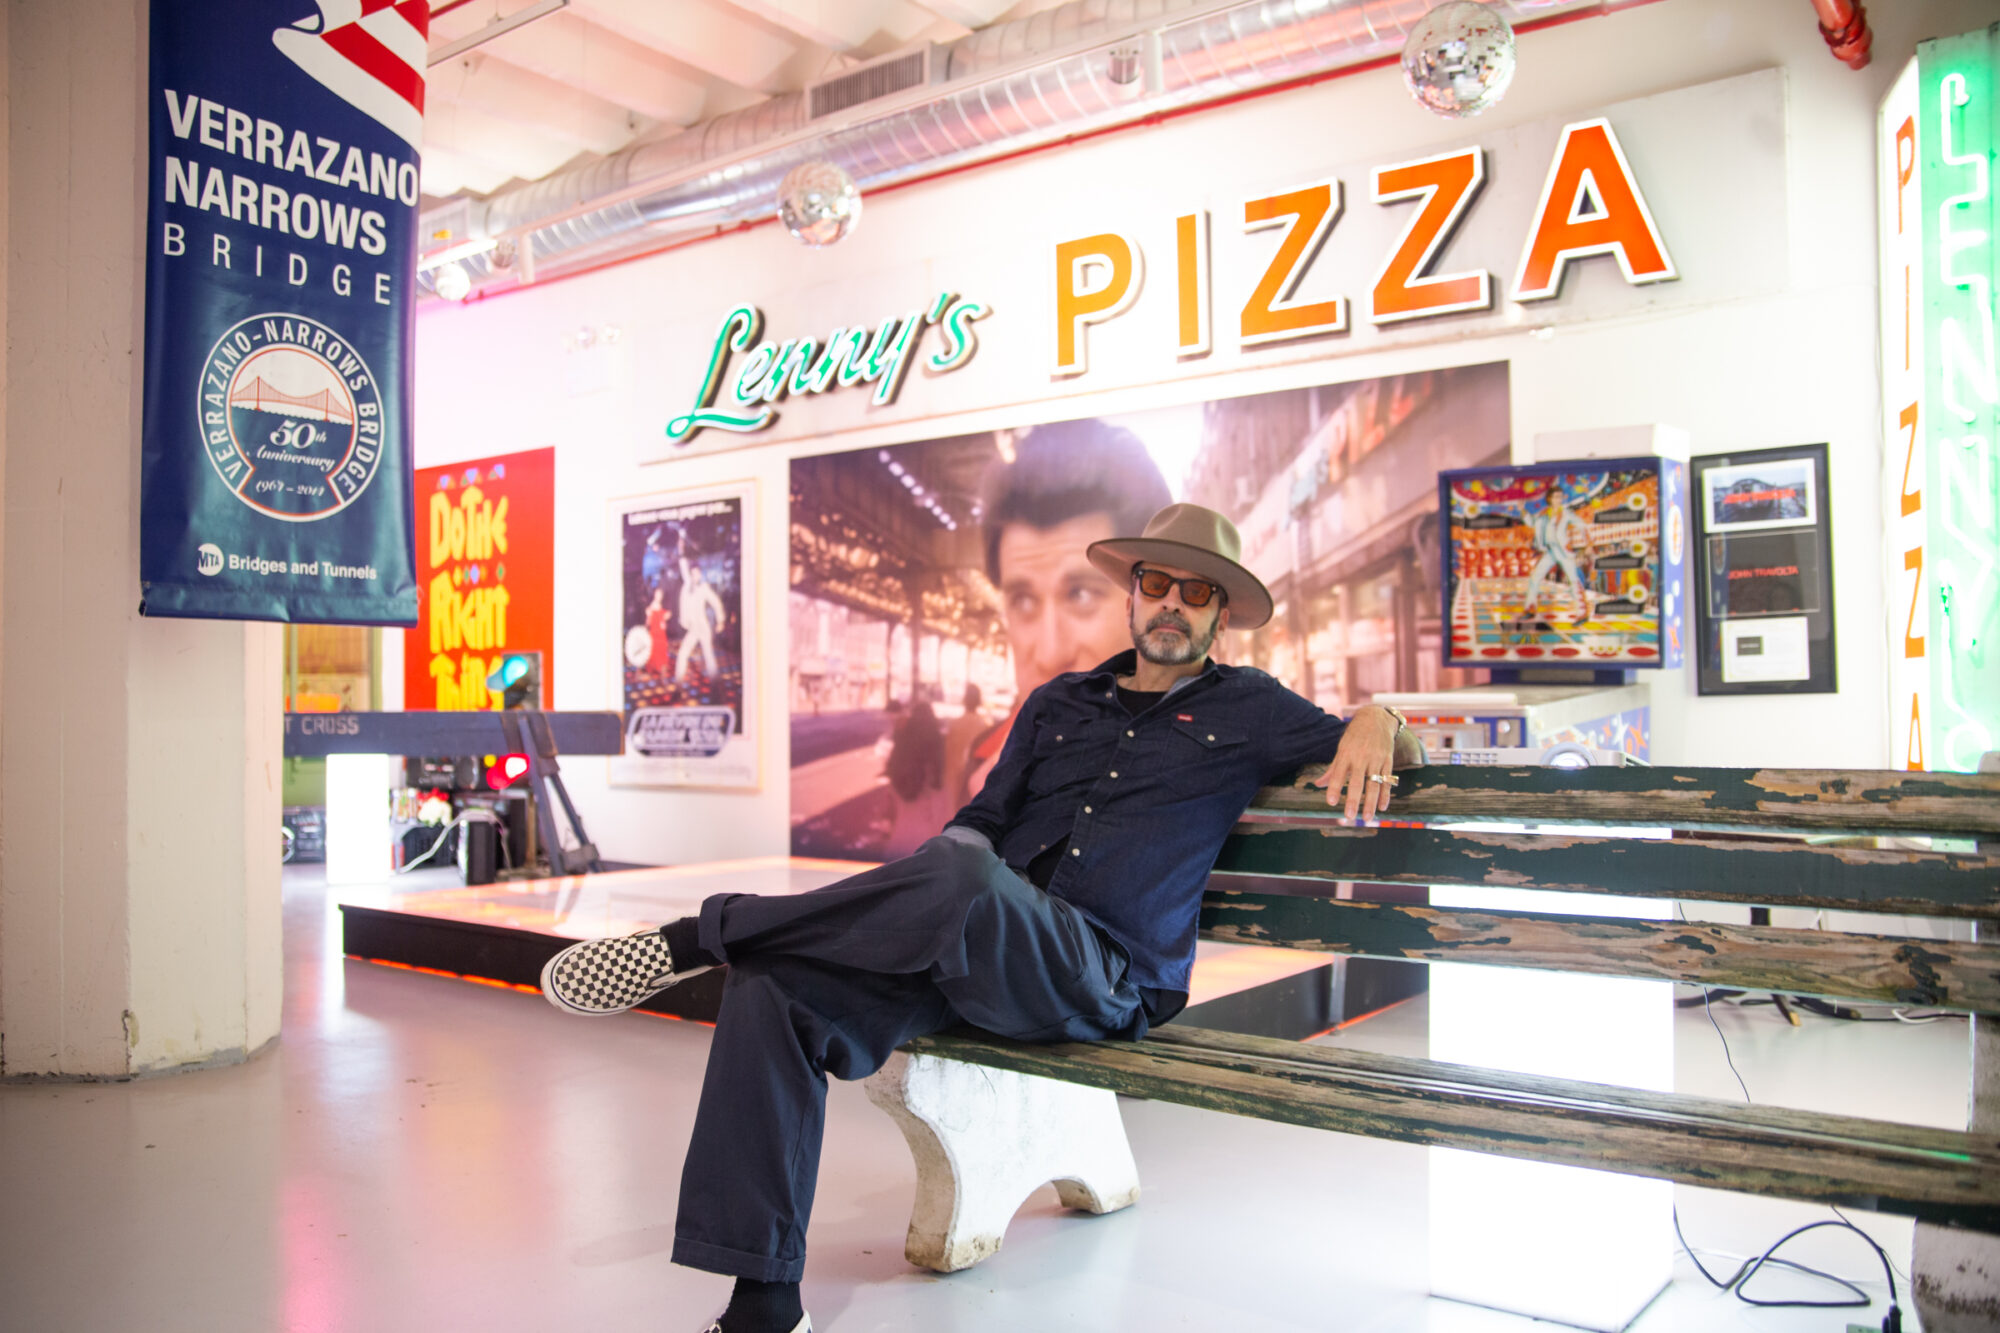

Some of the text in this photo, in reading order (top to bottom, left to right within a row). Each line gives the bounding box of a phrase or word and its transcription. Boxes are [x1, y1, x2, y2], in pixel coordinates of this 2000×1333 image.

[164, 88, 419, 207] VERRAZANO
[165, 155, 387, 255] NARROWS
[163, 222, 391, 305] BRIDGE
[665, 116, 1680, 443] Lenny's PIZZA
[247, 444, 335, 472] Anniversary
[269, 419, 327, 449] 50th
[337, 402, 379, 494] BRIDGE
[1896, 114, 1925, 771] PIZZA
[229, 554, 287, 575] Bridges
[291, 561, 318, 575] and
[322, 562, 377, 580] Tunnels
[1464, 547, 1532, 561] DISCO
[301, 716, 360, 735] CROSS
